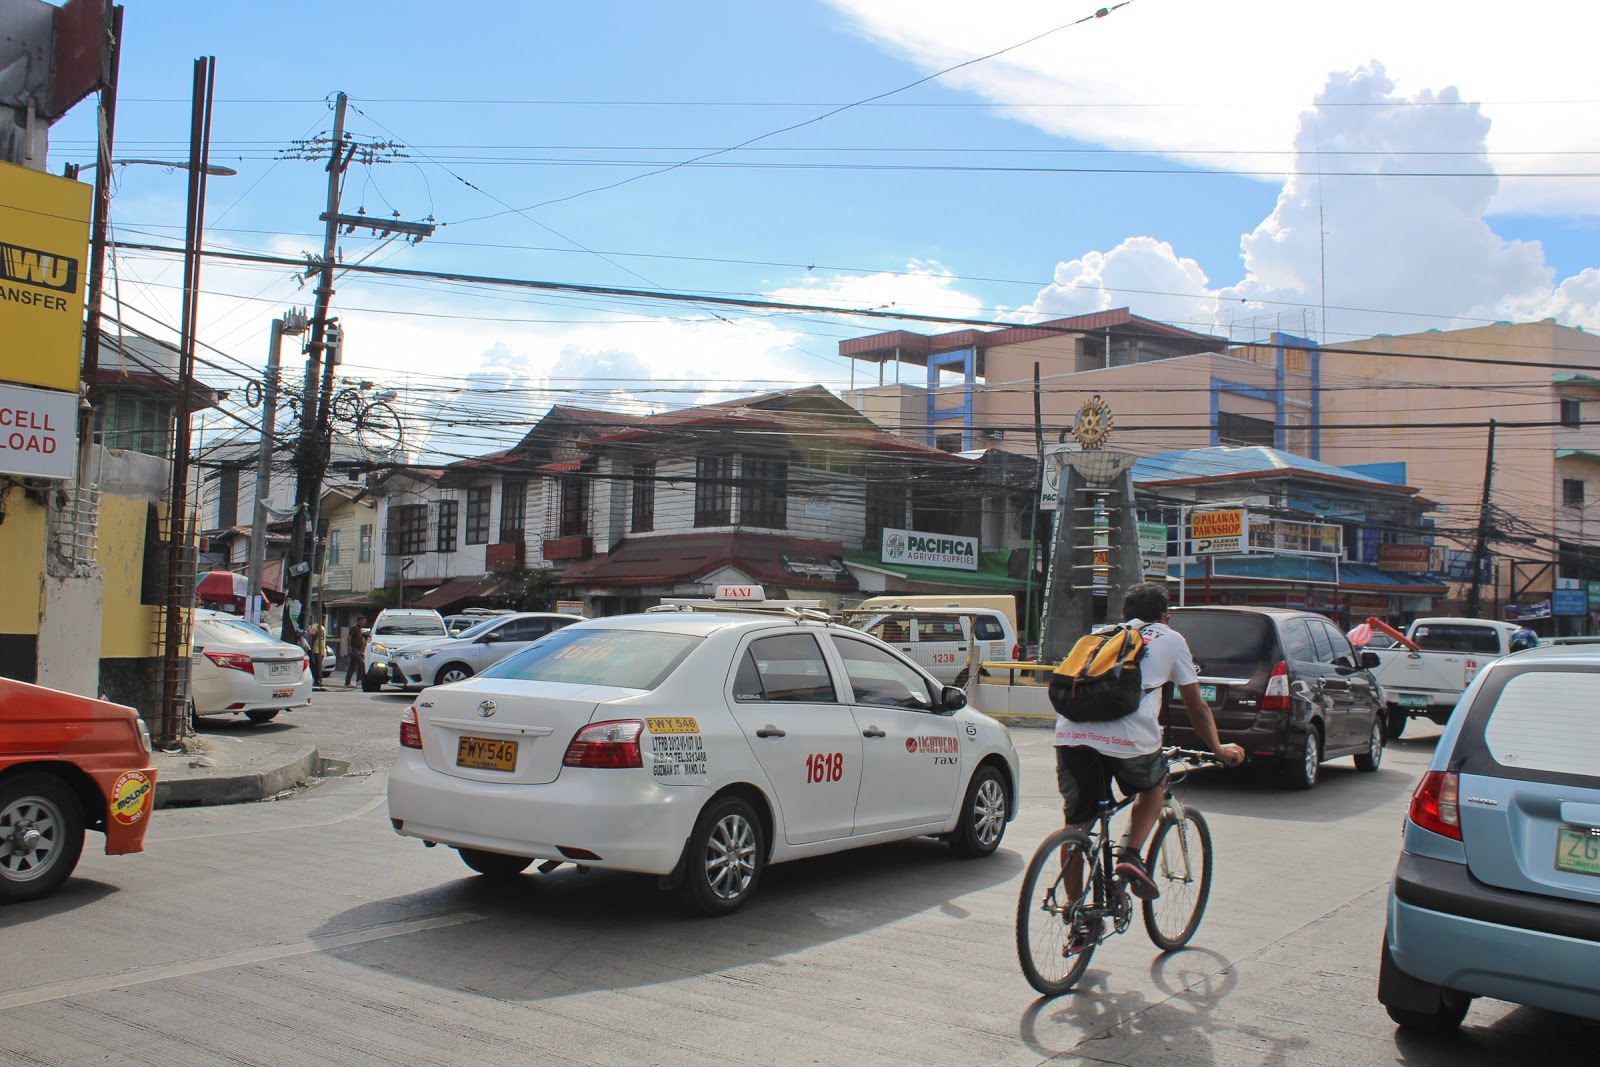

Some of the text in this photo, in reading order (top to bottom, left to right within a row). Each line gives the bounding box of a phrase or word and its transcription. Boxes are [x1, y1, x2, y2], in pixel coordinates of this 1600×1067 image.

[0, 286, 67, 312] ANSFER
[0, 408, 56, 431] CELL
[1201, 513, 1240, 525] PALAWAN
[1193, 524, 1240, 536] PAWNSHOP
[907, 536, 974, 556] PACIFICA
[907, 552, 975, 564] AGRIVET SUPPLIES
[722, 588, 752, 597] TAXI
[933, 653, 955, 663] 1238
[647, 719, 696, 729] FWY 546
[805, 752, 844, 784] 1618
